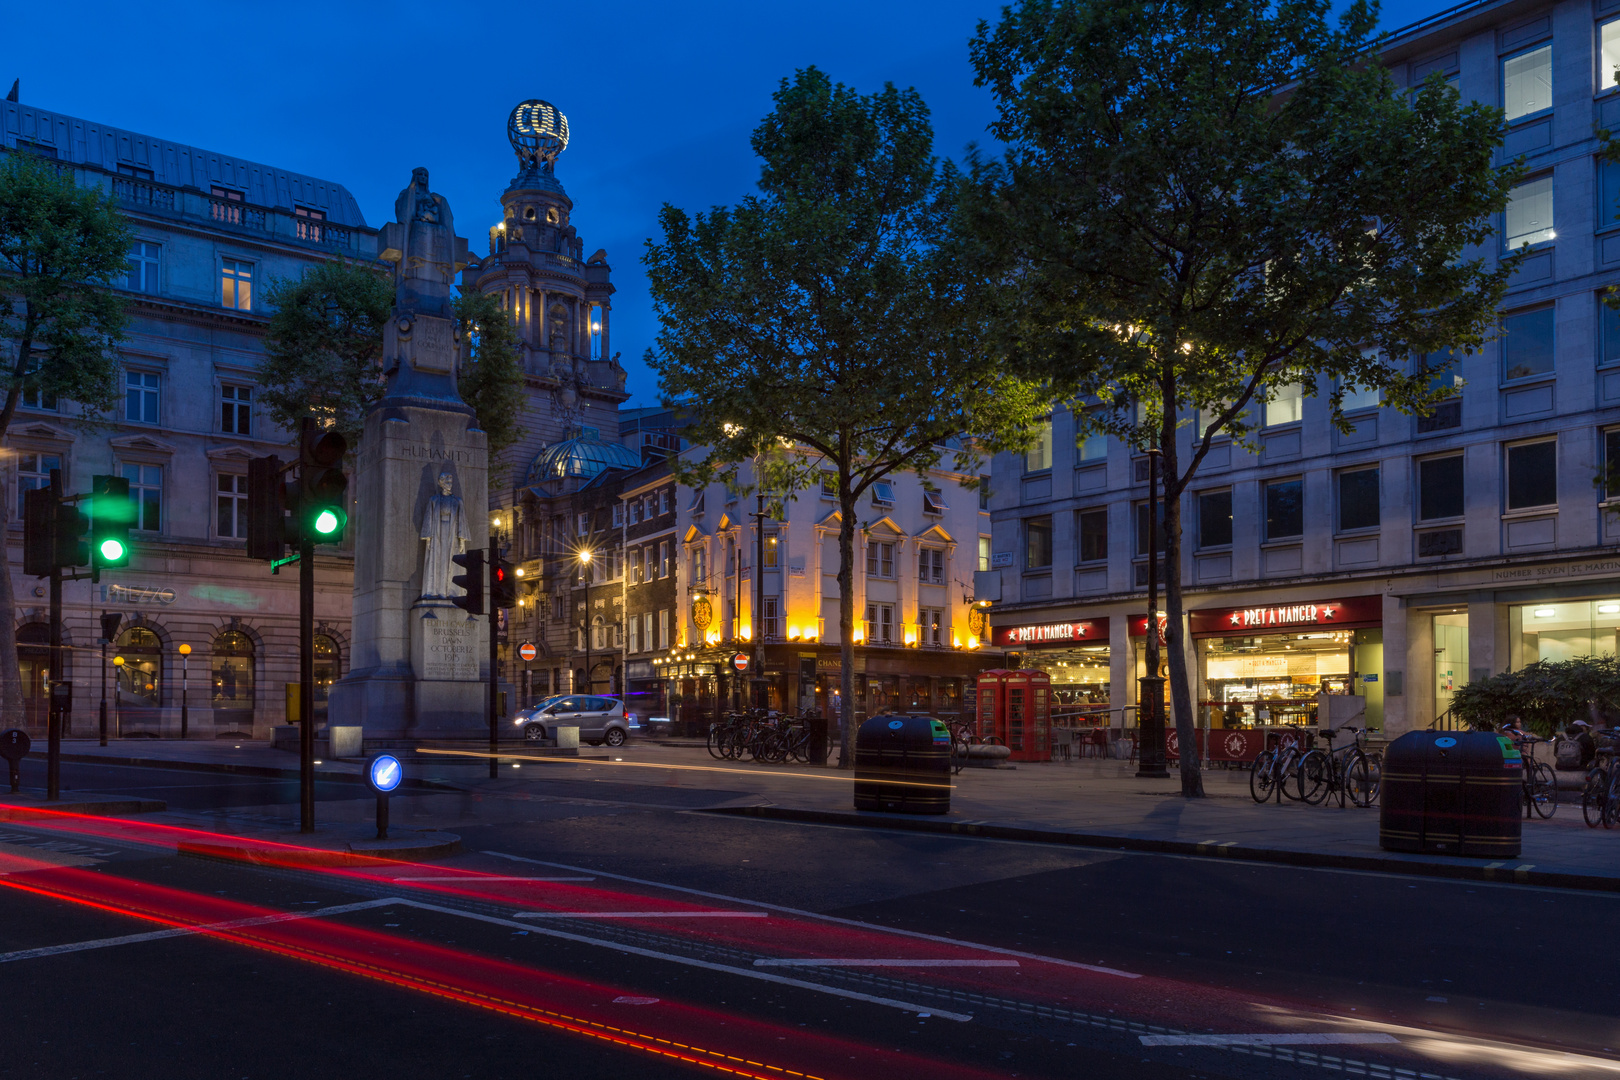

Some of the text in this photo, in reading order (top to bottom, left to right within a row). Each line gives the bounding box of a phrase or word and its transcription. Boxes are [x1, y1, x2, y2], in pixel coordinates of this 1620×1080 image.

[402, 445, 471, 462] HUMANITY
[1496, 569, 1532, 579] NUMBER
[1537, 566, 1565, 575] SEVEN
[106, 584, 177, 603] PREZZO
[1244, 604, 1317, 625] PRET A MANGER
[433, 628, 471, 636] BRUSSELS
[1019, 623, 1073, 641] PRET A MANGER
[431, 645, 465, 654] OCTOBER
[444, 653, 460, 662] 1915
[818, 659, 842, 667] CHAND
